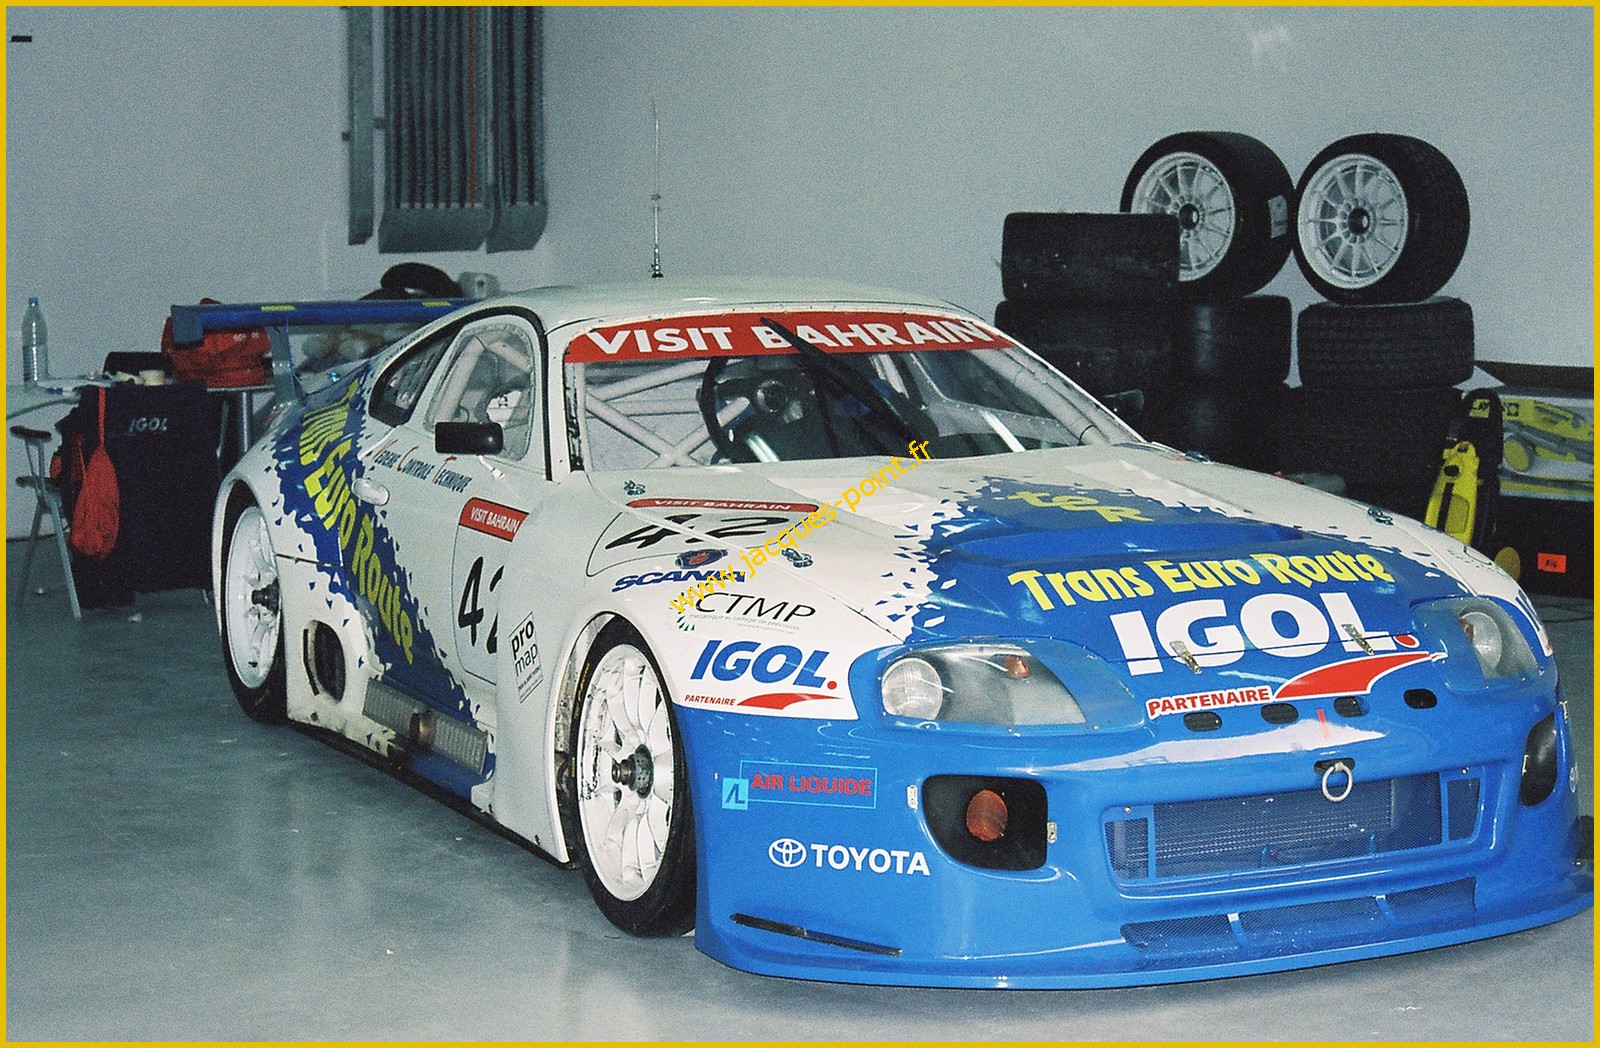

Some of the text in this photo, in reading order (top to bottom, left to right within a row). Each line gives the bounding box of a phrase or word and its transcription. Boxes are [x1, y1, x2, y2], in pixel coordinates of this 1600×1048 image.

[586, 317, 994, 354] VISIT BAHRAIN
[470, 507, 520, 533] VISIT BAHRAIN
[653, 499, 792, 511] VISIT BAHRAIN
[605, 513, 790, 550] 42
[304, 438, 357, 550] Euro
[352, 513, 413, 665] Route
[1008, 550, 1395, 611] Trans Euro Route
[695, 592, 817, 622] CTMP
[511, 620, 534, 661] pro
[515, 643, 539, 677] map
[684, 694, 736, 706] PARTENAIRE
[1148, 687, 1272, 717] PARTENAIRE
[751, 774, 872, 796] AIR LIQUIDE
[810, 843, 931, 876] TOYOTA
